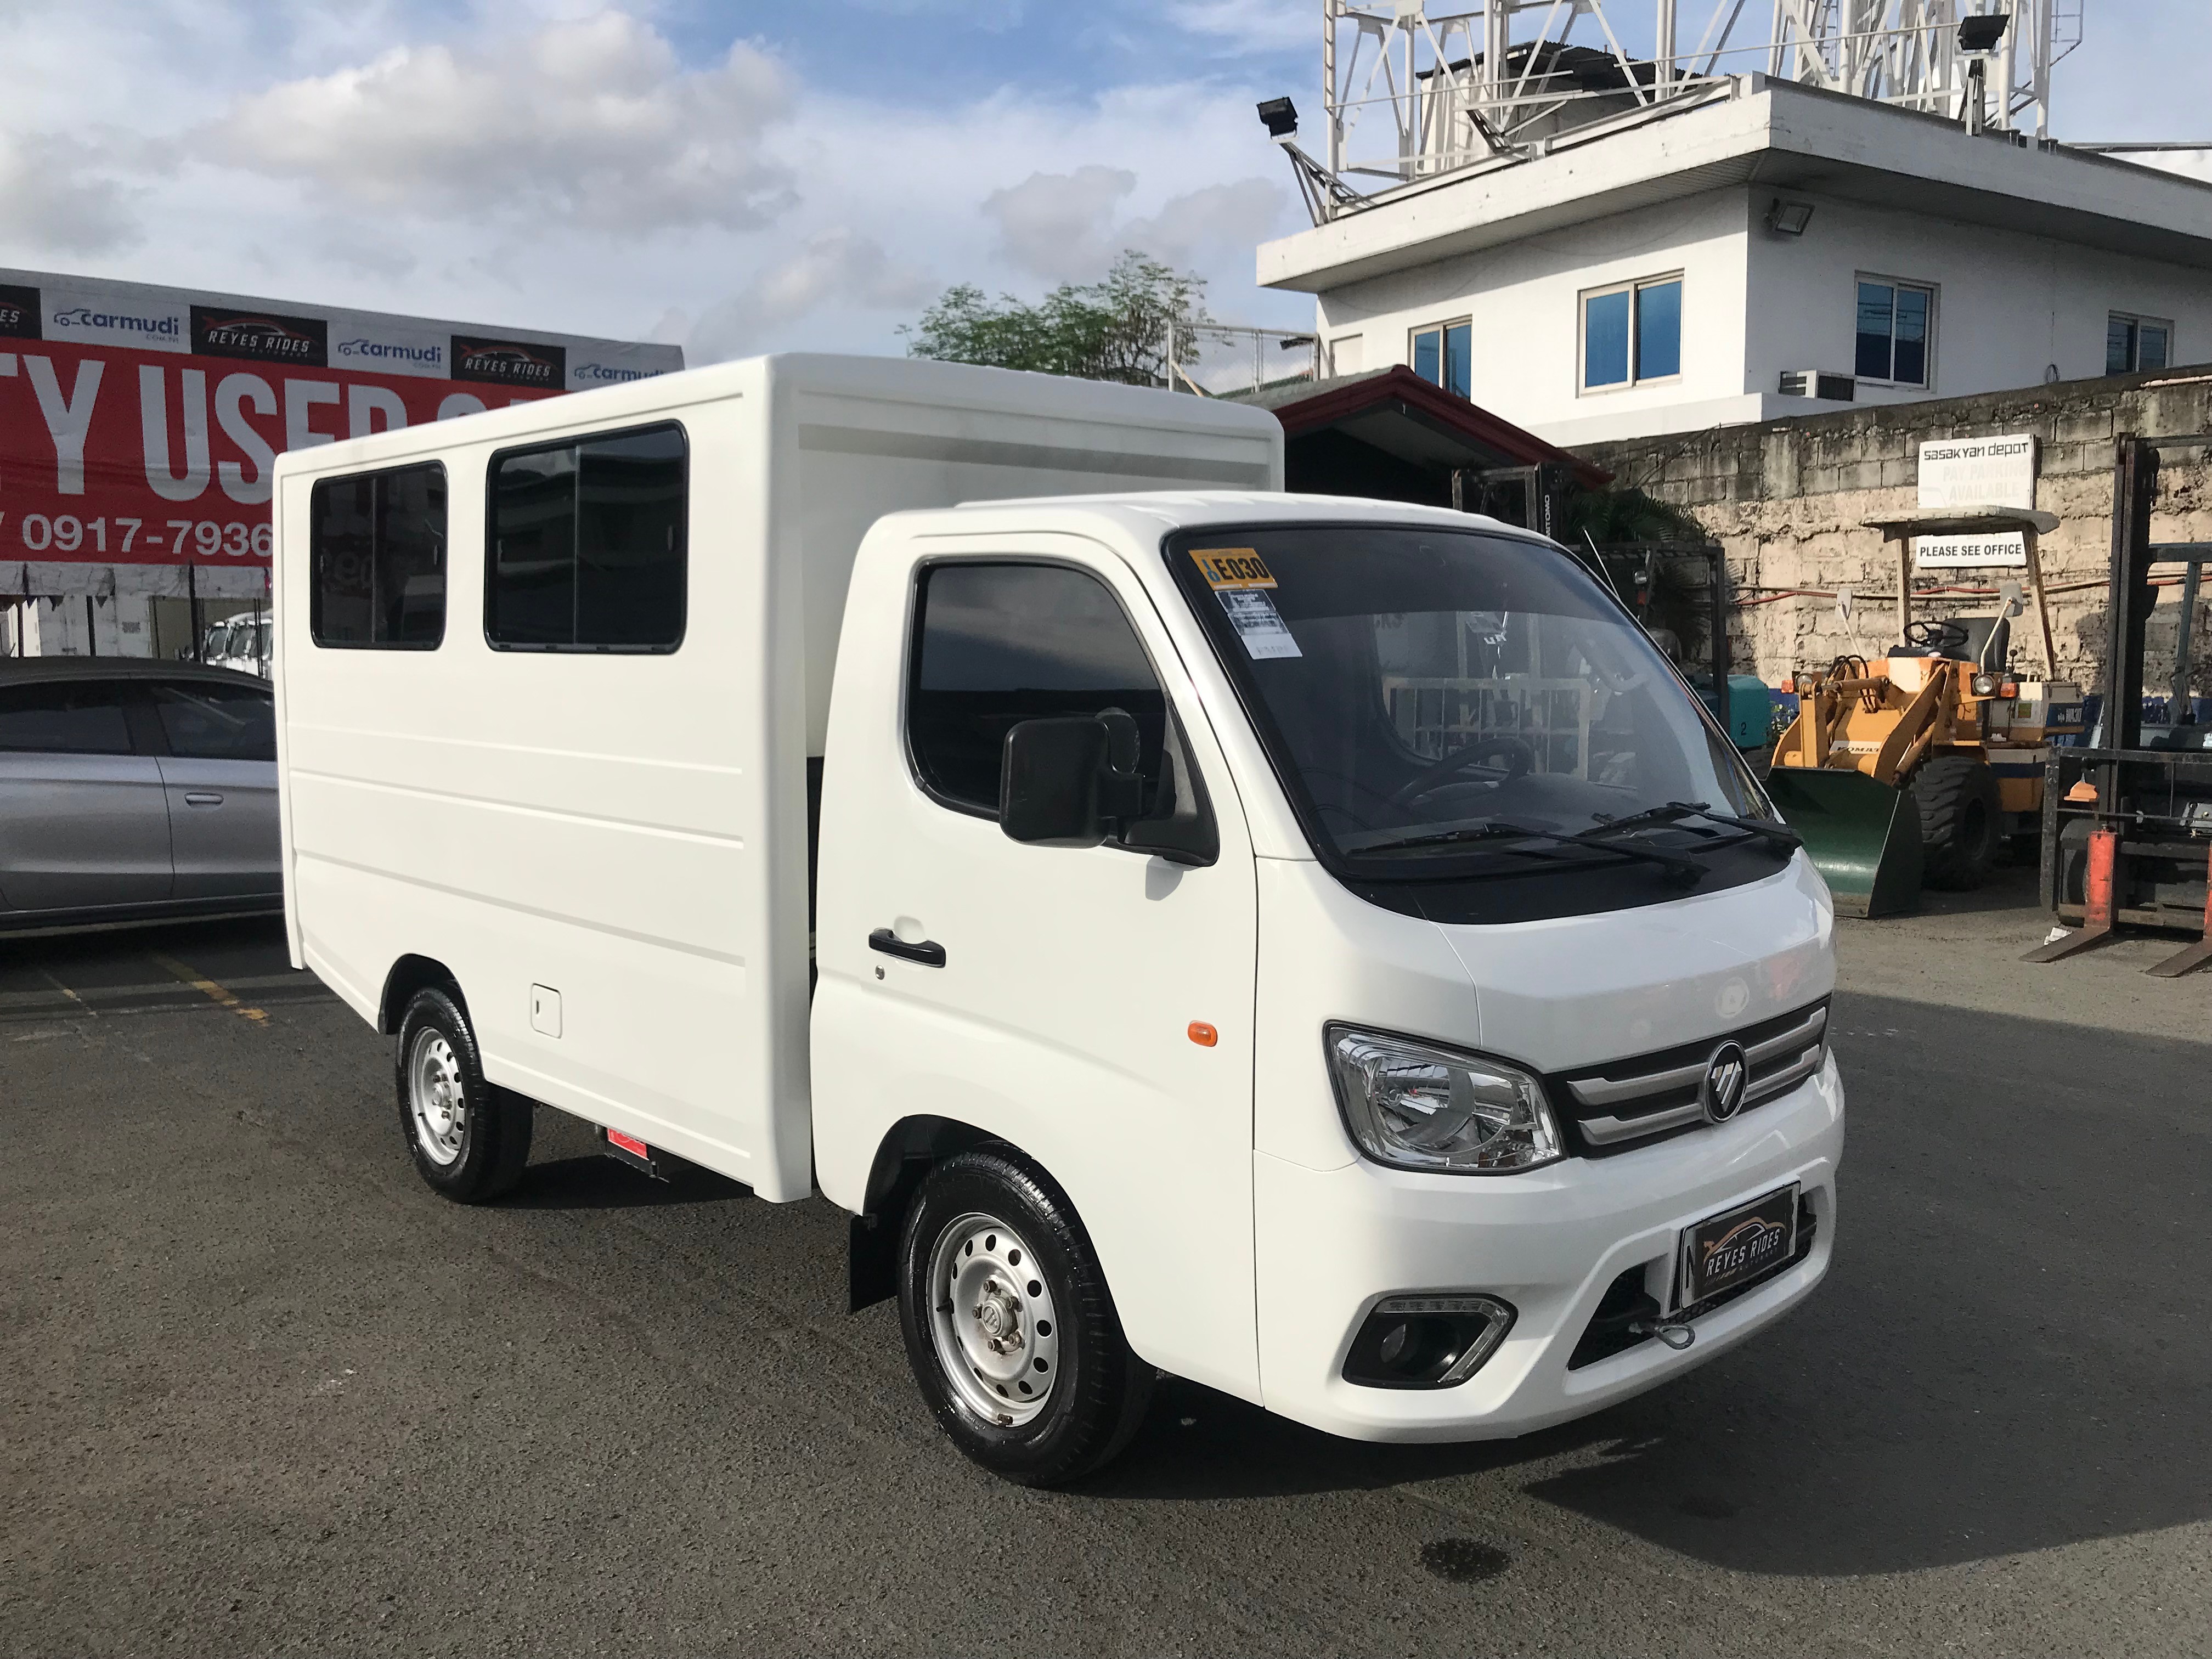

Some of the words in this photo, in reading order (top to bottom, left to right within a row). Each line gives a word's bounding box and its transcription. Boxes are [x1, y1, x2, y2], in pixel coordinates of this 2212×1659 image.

[80, 313, 179, 335] carmudi
[208, 330, 258, 347] REYES
[265, 337, 310, 353] RIDES
[360, 342, 441, 363] carmudi
[464, 357, 507, 373] REYES
[512, 362, 551, 377] RIDES
[592, 368, 665, 381] carm
[1943, 466, 1968, 482] PAY
[1970, 460, 2028, 481] PARKING
[1948, 482, 2019, 501] AVAILABLE
[22, 514, 273, 557] 0917-7936
[1920, 545, 1958, 557] PLEASE
[1961, 545, 1981, 556] SEE
[1984, 543, 2022, 555] OFFICE
[1211, 557, 1271, 580] E030
[1740, 721, 1747, 736] 2
[1706, 1245, 1746, 1277] REYES
[1750, 1228, 1780, 1259] RIDES
